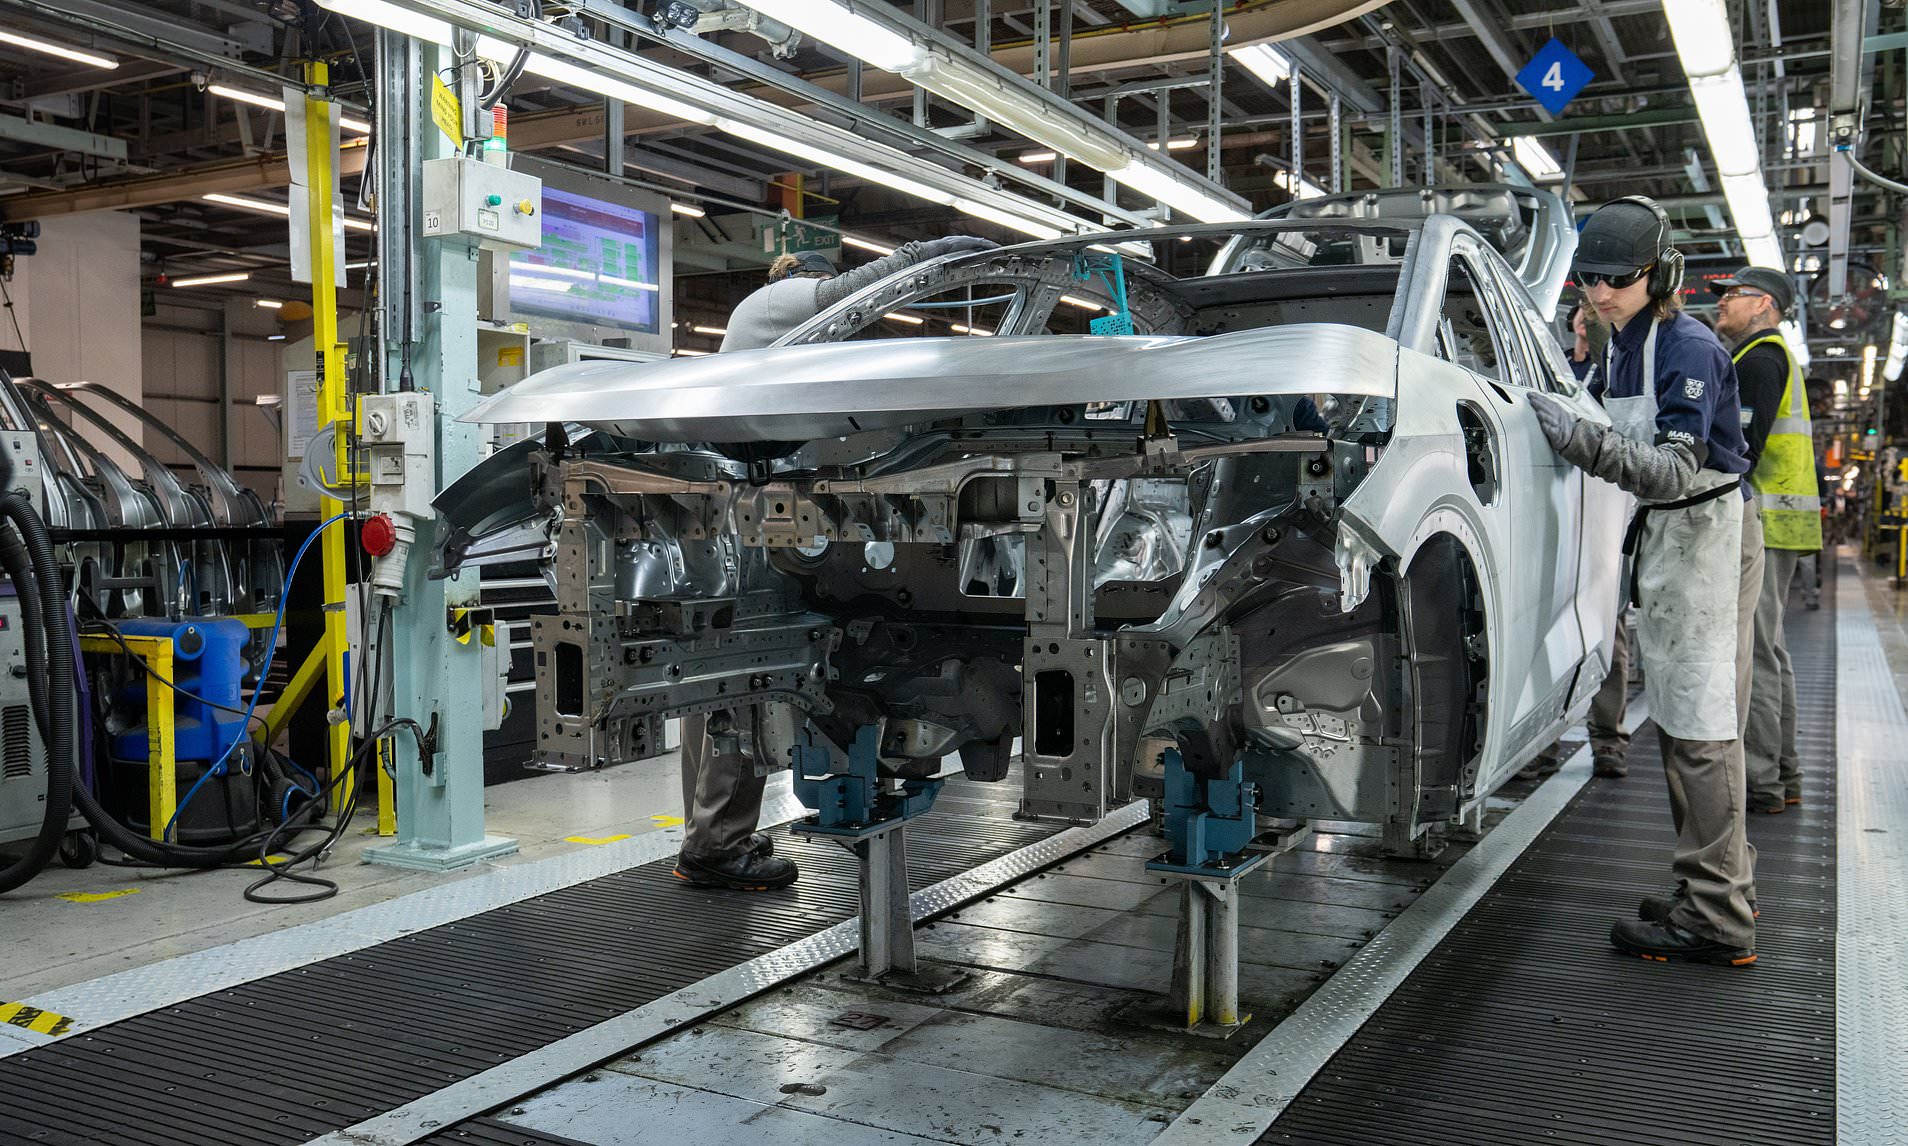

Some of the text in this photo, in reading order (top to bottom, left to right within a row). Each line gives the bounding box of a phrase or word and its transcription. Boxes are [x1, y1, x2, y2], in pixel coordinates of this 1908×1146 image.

[1542, 61, 1565, 91] 4
[427, 217, 439, 228] 10
[815, 234, 835, 246] EXIT
[1667, 430, 1695, 446] MAPA
